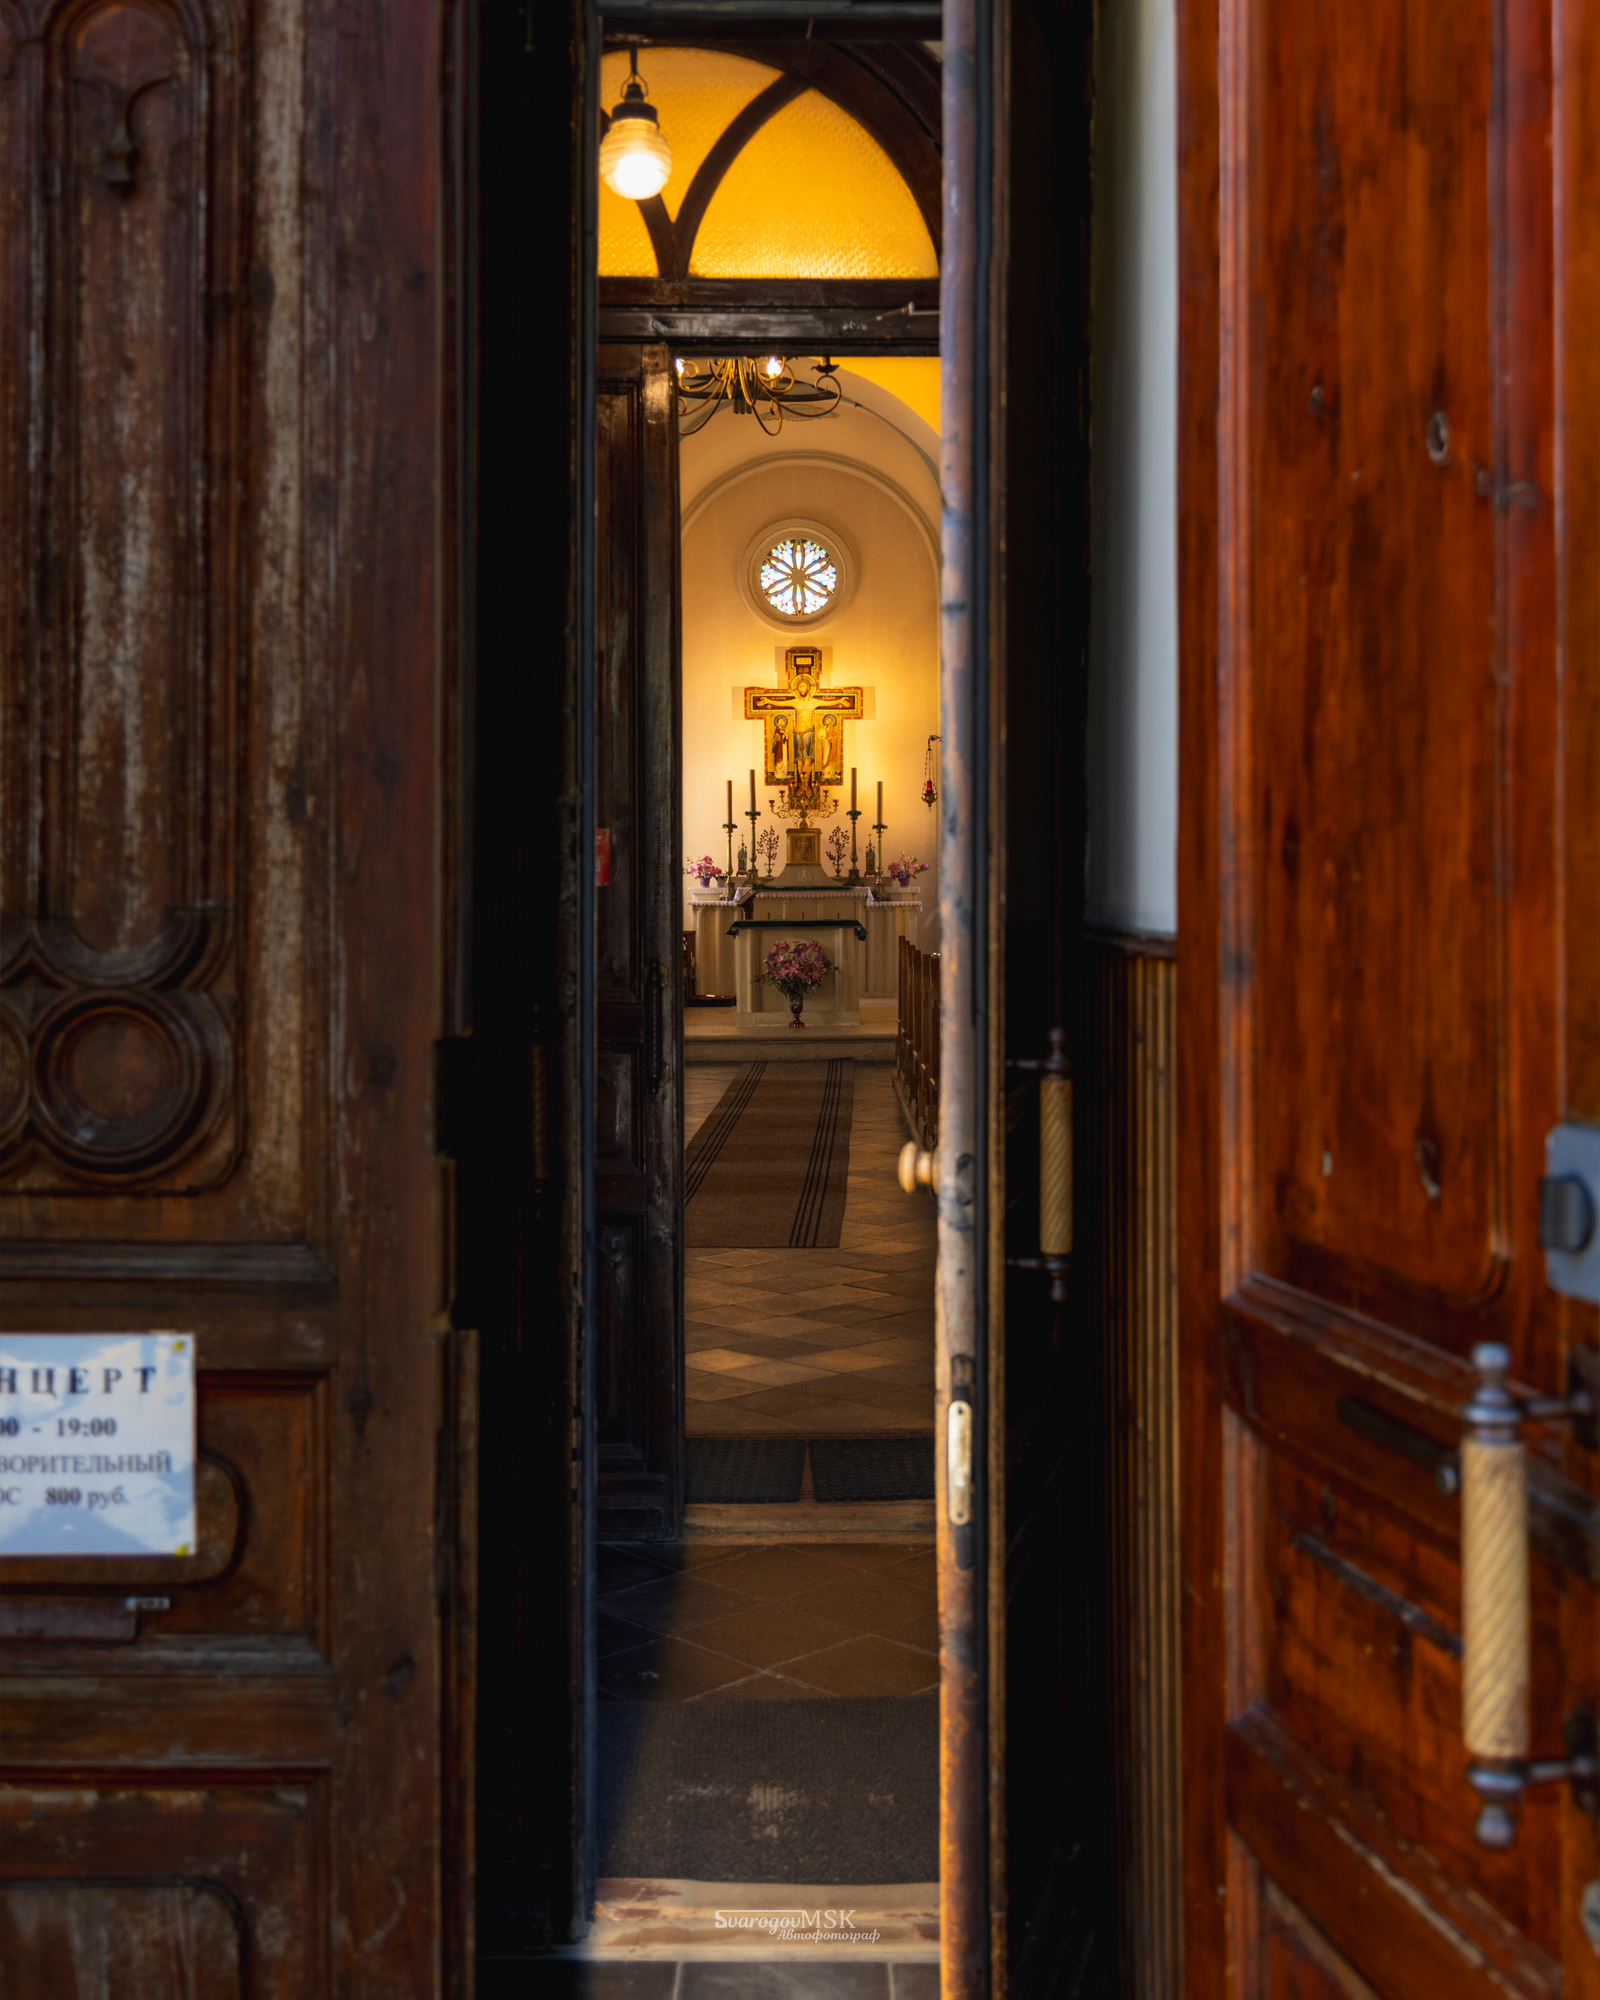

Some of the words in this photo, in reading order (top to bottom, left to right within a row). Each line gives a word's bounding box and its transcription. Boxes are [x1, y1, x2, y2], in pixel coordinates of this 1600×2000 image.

[0, 1366, 156, 1397] НЦЕРТ
[57, 1418, 117, 1437] 19:00
[46, 1487, 81, 1505] 800
